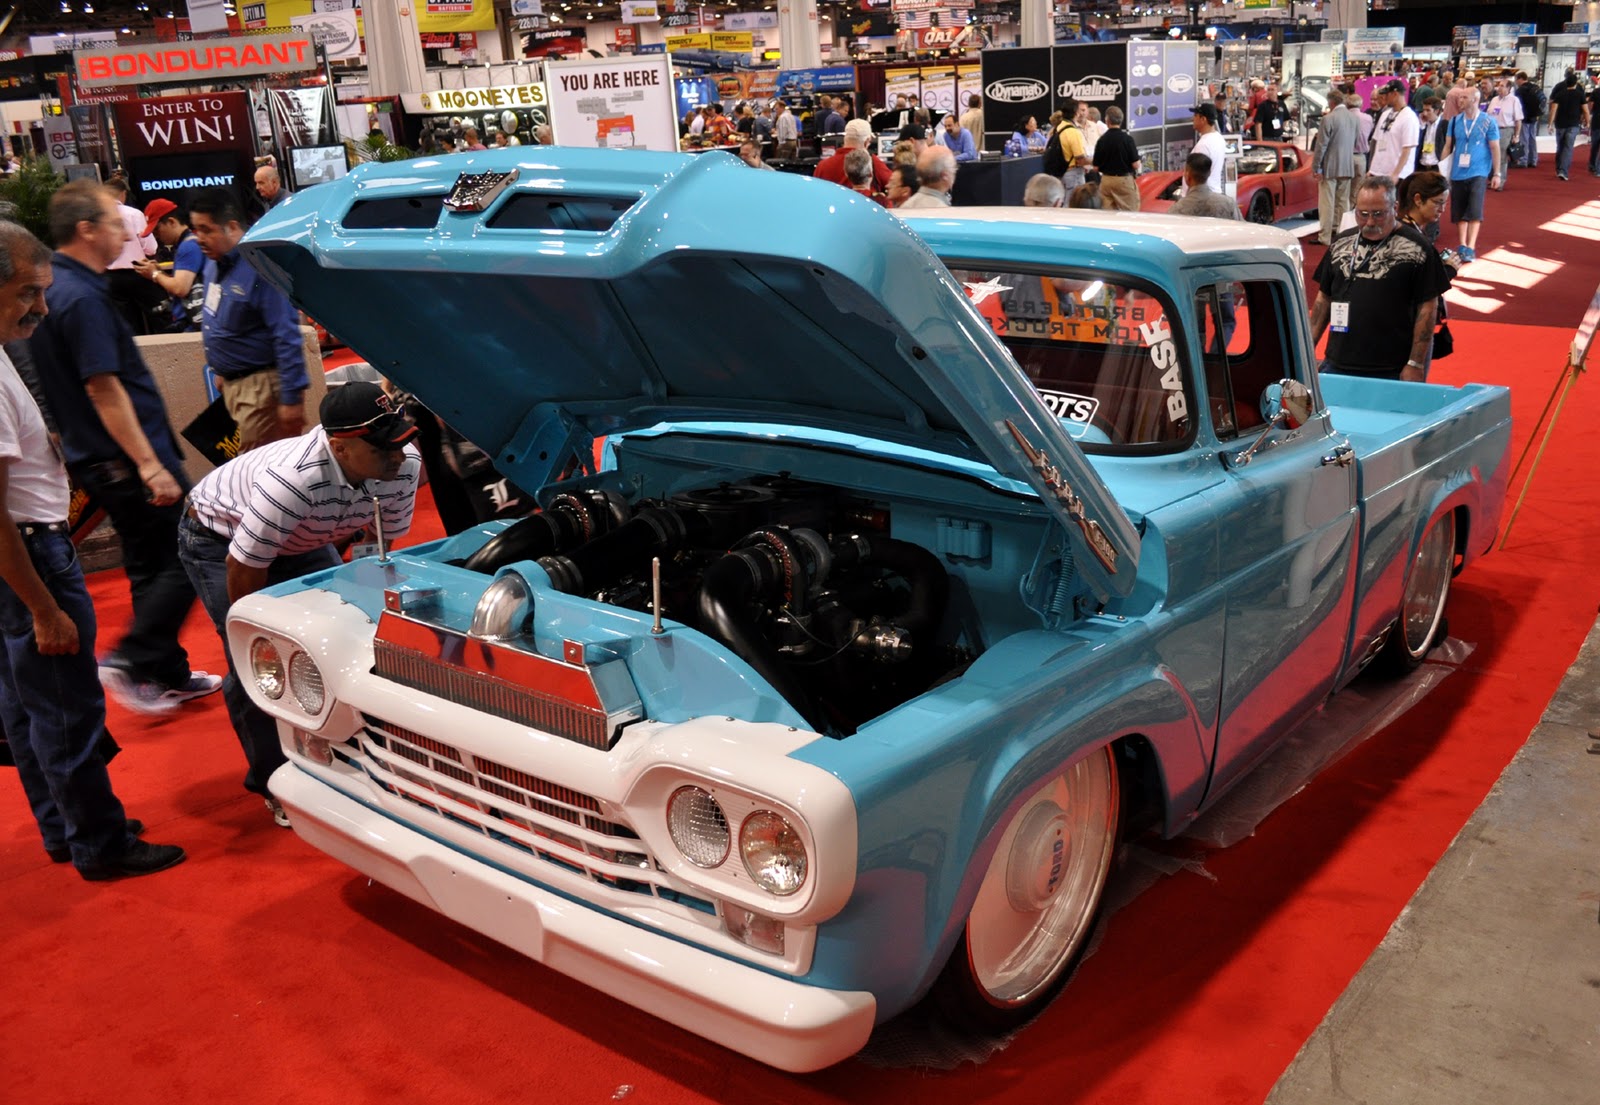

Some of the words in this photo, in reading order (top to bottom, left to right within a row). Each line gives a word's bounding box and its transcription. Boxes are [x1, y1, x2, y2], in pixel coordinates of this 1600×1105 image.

[924, 31, 953, 46] QA1
[87, 40, 309, 80] BONDURANT
[560, 74, 588, 92] YOU
[593, 72, 620, 89] ARE
[624, 69, 660, 87] HERE
[994, 83, 1042, 98] Dynamat
[1062, 79, 1118, 99] Dynaliner
[143, 102, 196, 117] ENTER
[198, 98, 223, 112] TO
[437, 85, 544, 109] MOONEYES
[136, 115, 235, 148] WIN!
[141, 175, 234, 191] BONDURANT
[1139, 320, 1188, 422] BASF
